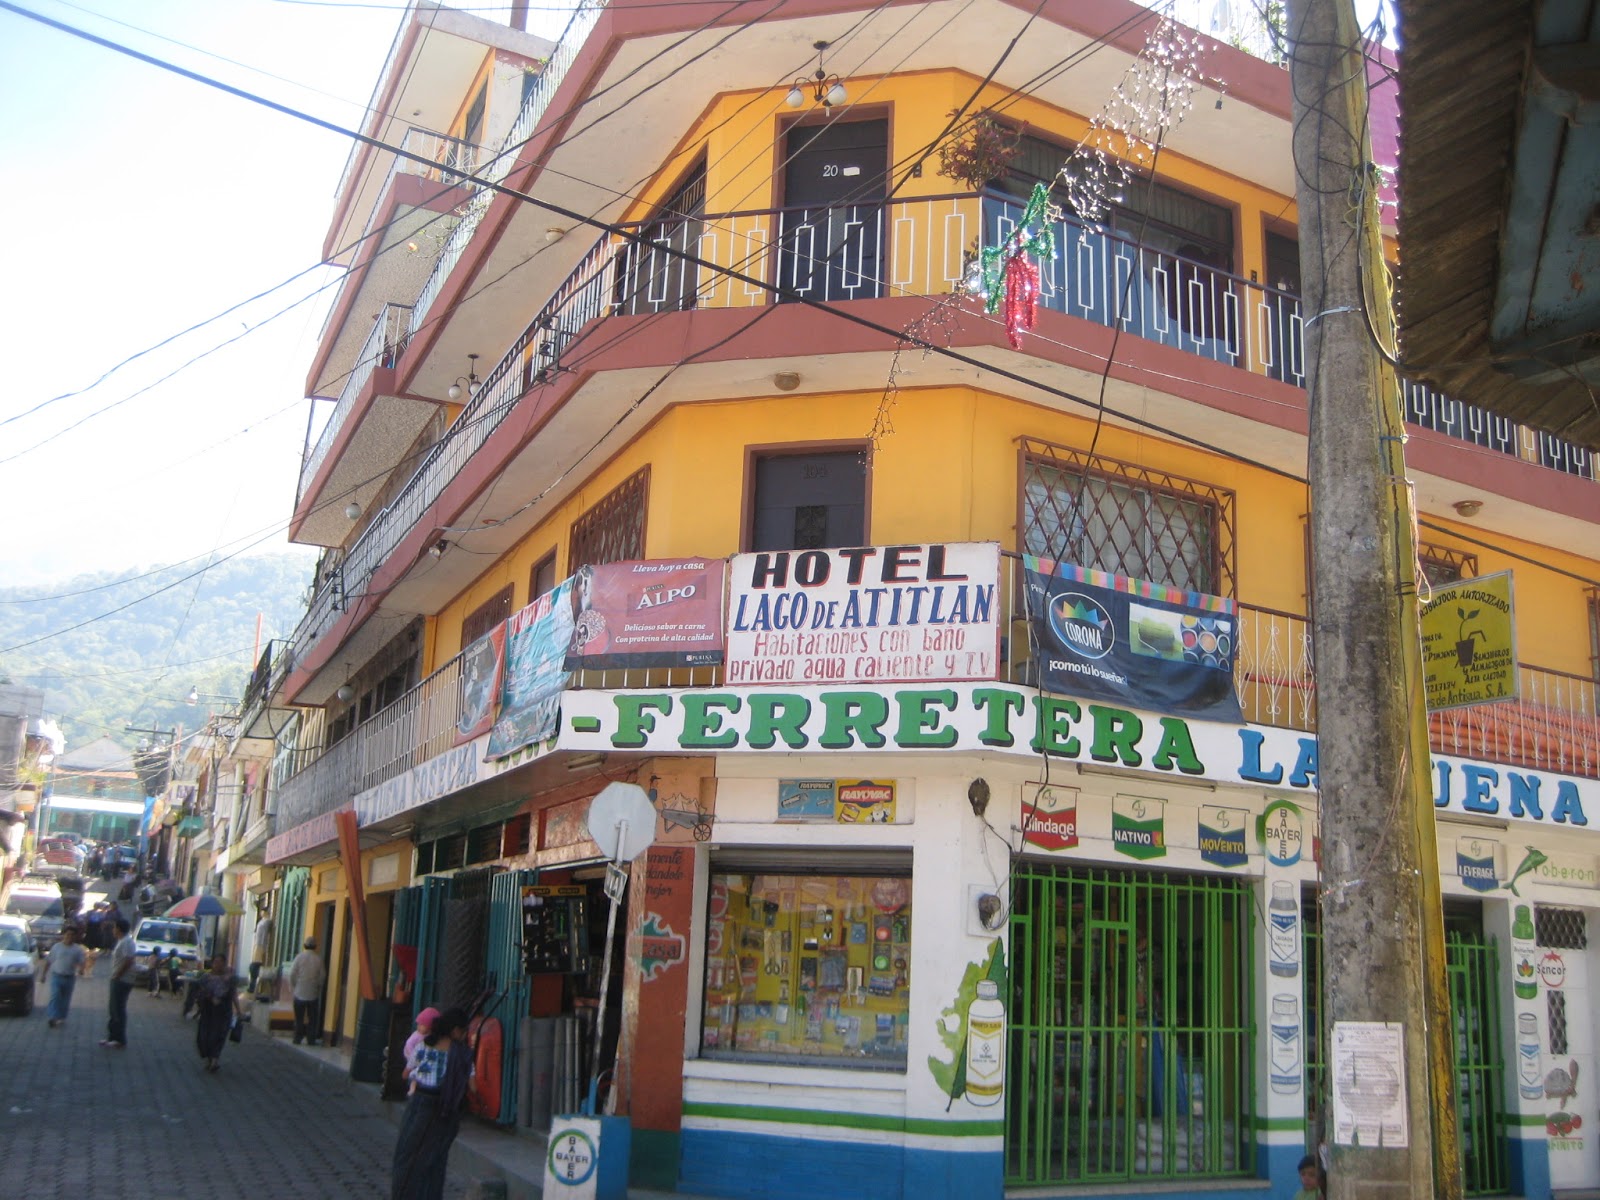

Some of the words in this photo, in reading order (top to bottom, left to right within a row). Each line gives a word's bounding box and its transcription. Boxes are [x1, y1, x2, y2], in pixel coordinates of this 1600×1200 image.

[822, 165, 839, 177] 20
[632, 565, 657, 573] Lleva
[658, 564, 675, 573] hoy
[751, 545, 969, 589] HOTEL
[636, 585, 696, 610] ALPO
[733, 591, 809, 632] LAGO
[811, 600, 839, 630] DE
[840, 584, 995, 628] ATITLAN
[687, 633, 714, 641] calidad
[754, 629, 868, 657] Habitaciones
[879, 629, 910, 652] con
[1065, 622, 1103, 650] CORONA
[730, 657, 795, 682] privado
[854, 654, 935, 678] caliente
[945, 657, 955, 676] y
[1091, 664, 1099, 677] lo
[1237, 729, 1319, 789] LA
[841, 789, 892, 801] RAYOVAC
[1114, 830, 1151, 845] NATIVO
[1266, 828, 1301, 841] BAYER
[1279, 808, 1288, 859] BAYER
[1200, 837, 1244, 853] MOVENTO
[1458, 864, 1495, 880] LEVERAGE
[1537, 963, 1566, 975] Sencor
[556, 1152, 589, 1164] BAYER
[567, 1136, 576, 1179] BAYER
